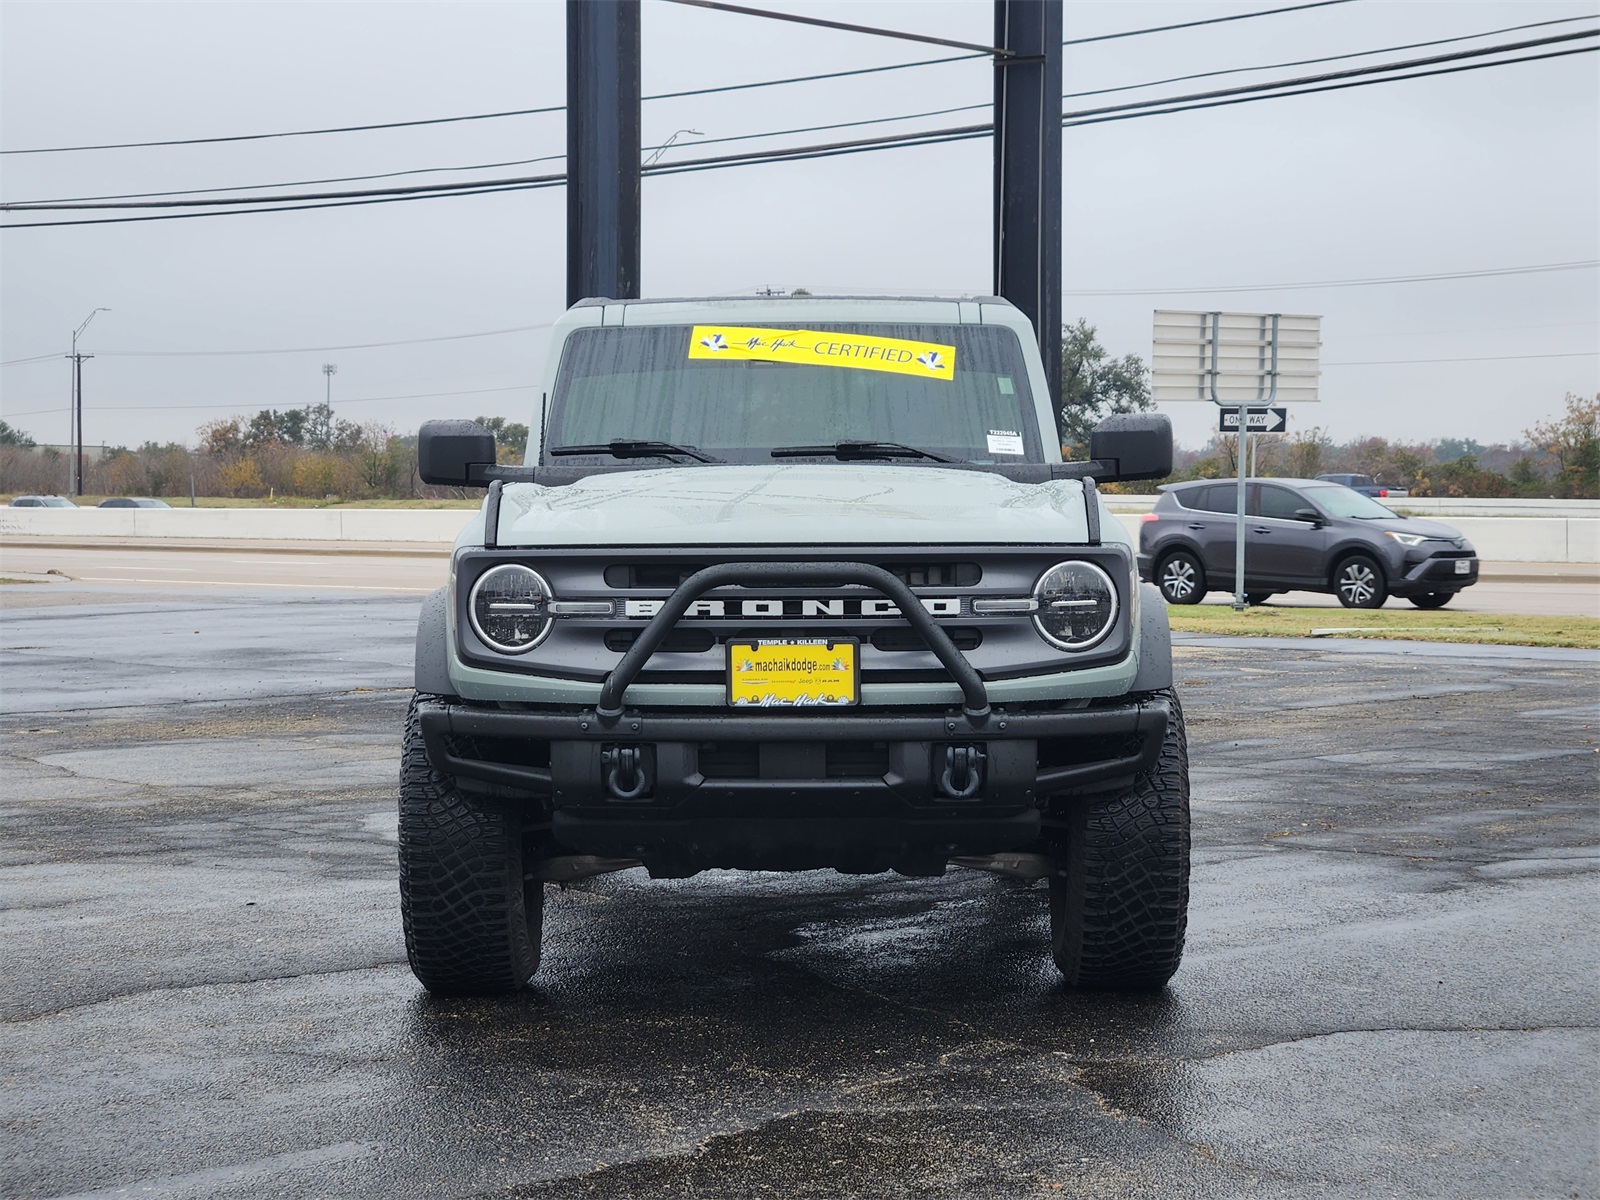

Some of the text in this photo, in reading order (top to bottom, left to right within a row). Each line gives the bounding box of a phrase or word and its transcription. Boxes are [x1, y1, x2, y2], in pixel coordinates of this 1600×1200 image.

[732, 337, 913, 363] Mac Haik CERTIFIED
[1249, 416, 1266, 424] WAY
[625, 600, 961, 616] BRONCO
[755, 658, 831, 674] machaikdodge.com
[760, 693, 829, 707] Mac Haik
